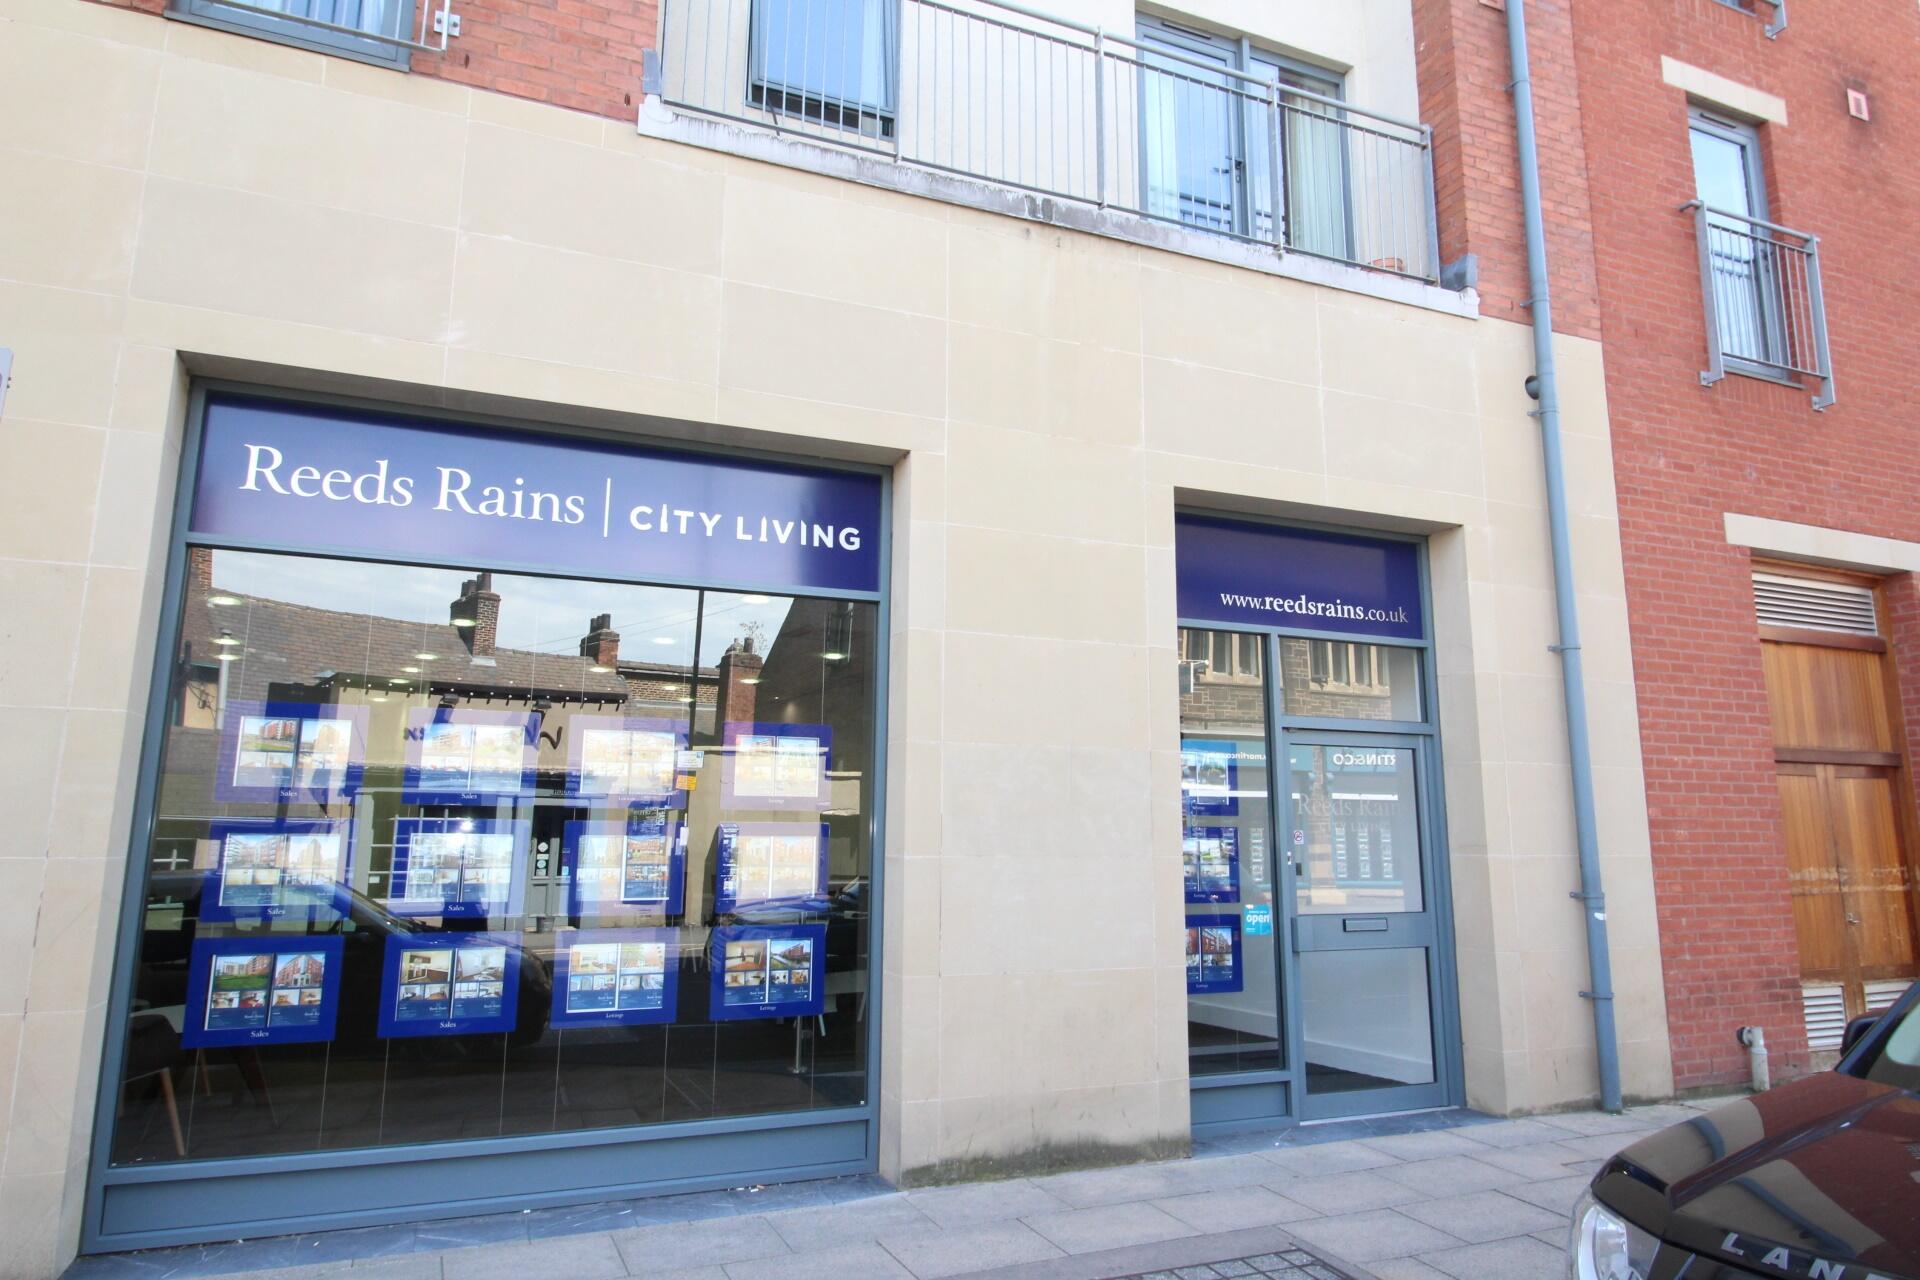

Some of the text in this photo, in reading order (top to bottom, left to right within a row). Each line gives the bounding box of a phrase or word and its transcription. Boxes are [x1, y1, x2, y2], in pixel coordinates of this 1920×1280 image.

[238, 443, 585, 524] Reeds Rains
[629, 503, 861, 551] CITY LIVING
[1220, 593, 1408, 623] www.reedsrains.co.uk
[280, 789, 298, 797] Sales
[1297, 793, 1353, 816] Reeds
[267, 907, 286, 915] Sales
[1246, 913, 1270, 925] open
[439, 1020, 457, 1028] Sales
[250, 1029, 270, 1038] Sales
[1720, 1231, 1891, 1280] LAN
